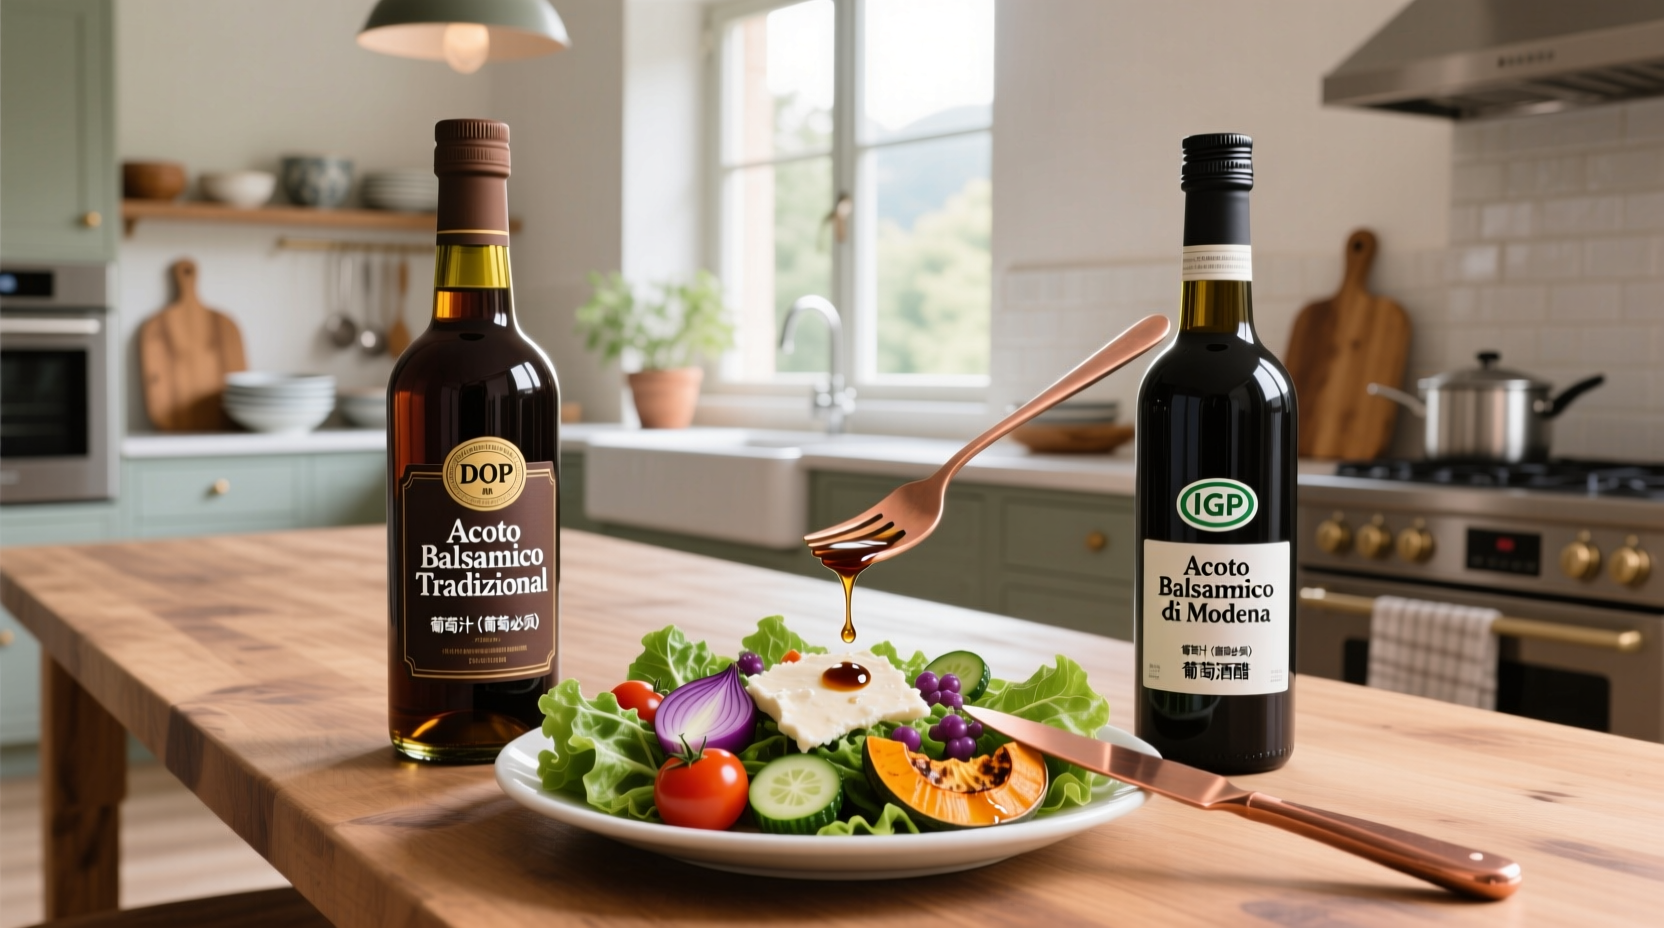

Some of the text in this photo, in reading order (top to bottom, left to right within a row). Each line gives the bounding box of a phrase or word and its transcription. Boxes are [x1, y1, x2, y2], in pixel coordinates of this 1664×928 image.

[460, 463, 513, 484] DOP
[1194, 493, 1244, 516] IGP
[446, 518, 521, 543] Acoto
[420, 543, 544, 569] Balsamico
[1183, 555, 1250, 576] Acoto
[415, 567, 548, 597] Tradizional
[1158, 576, 1274, 599] Balsamico
[1161, 600, 1271, 624] di Modena
